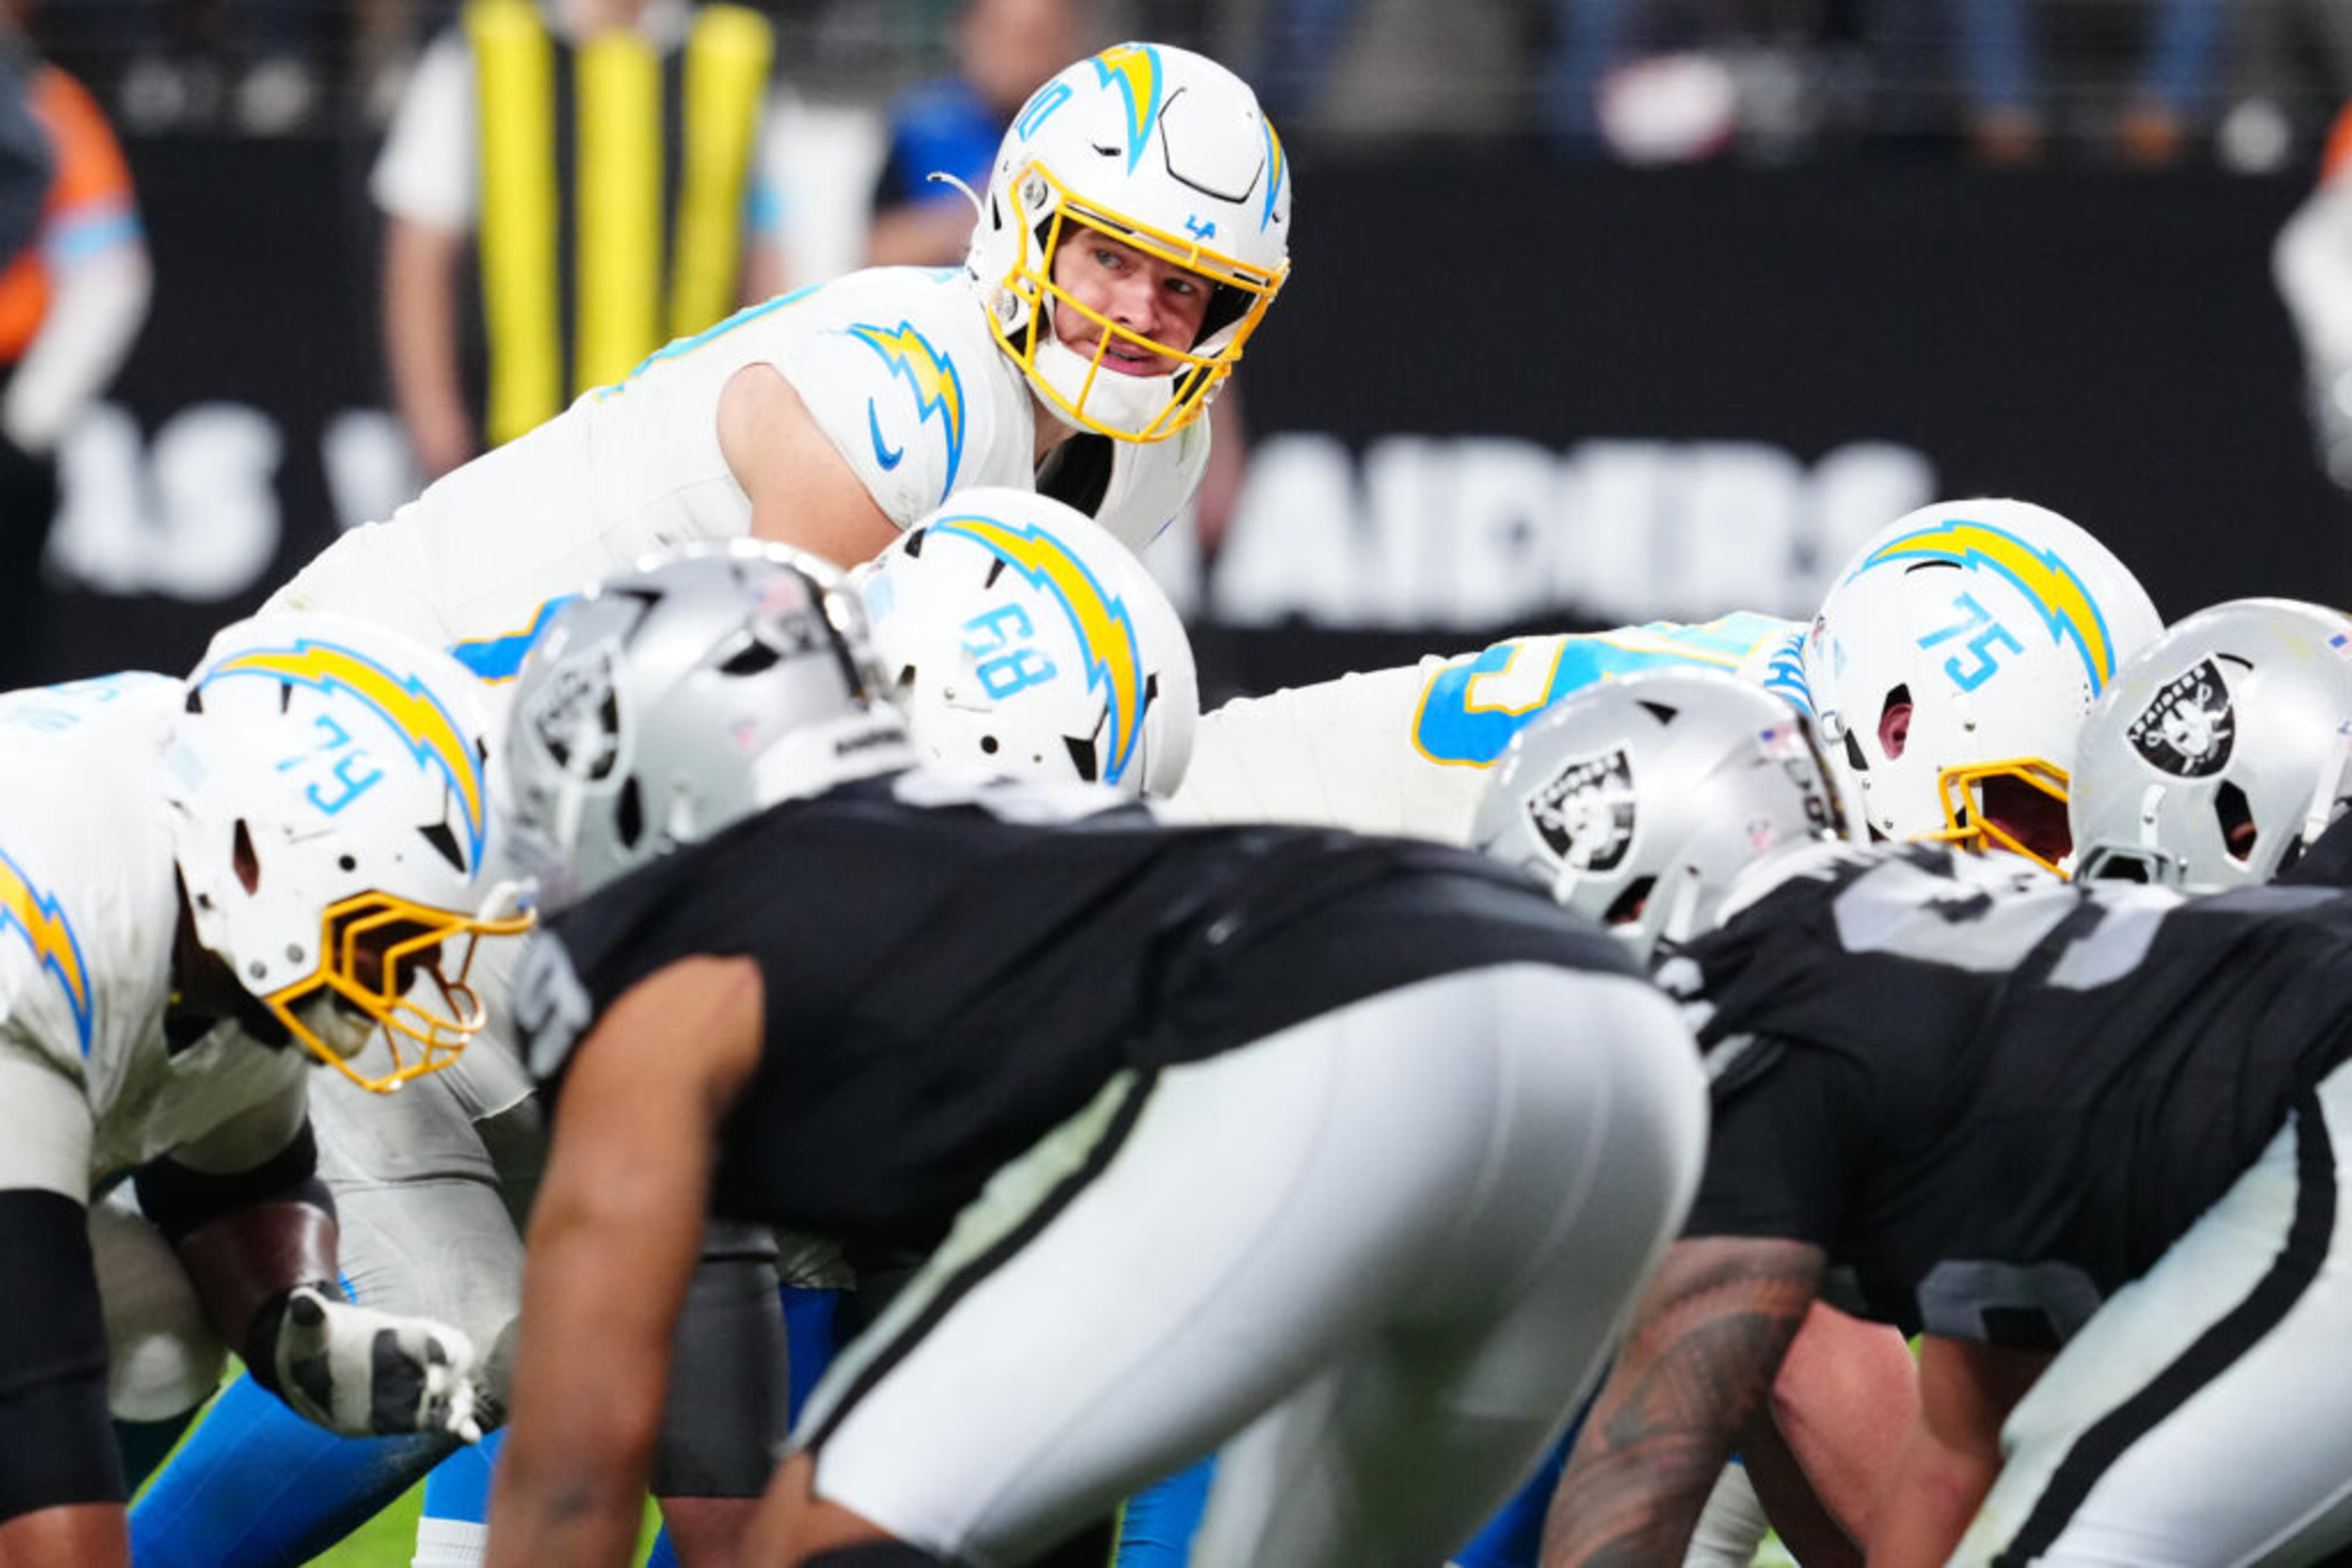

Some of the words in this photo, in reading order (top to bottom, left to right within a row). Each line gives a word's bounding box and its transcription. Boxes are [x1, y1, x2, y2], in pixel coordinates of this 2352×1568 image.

[1184, 213, 1216, 241] LA
[49, 400, 284, 602] AS
[1140, 431, 1938, 628] AIDERS
[961, 603, 1057, 701] 68
[1916, 592, 2025, 692] 75
[276, 715, 384, 816] 79
